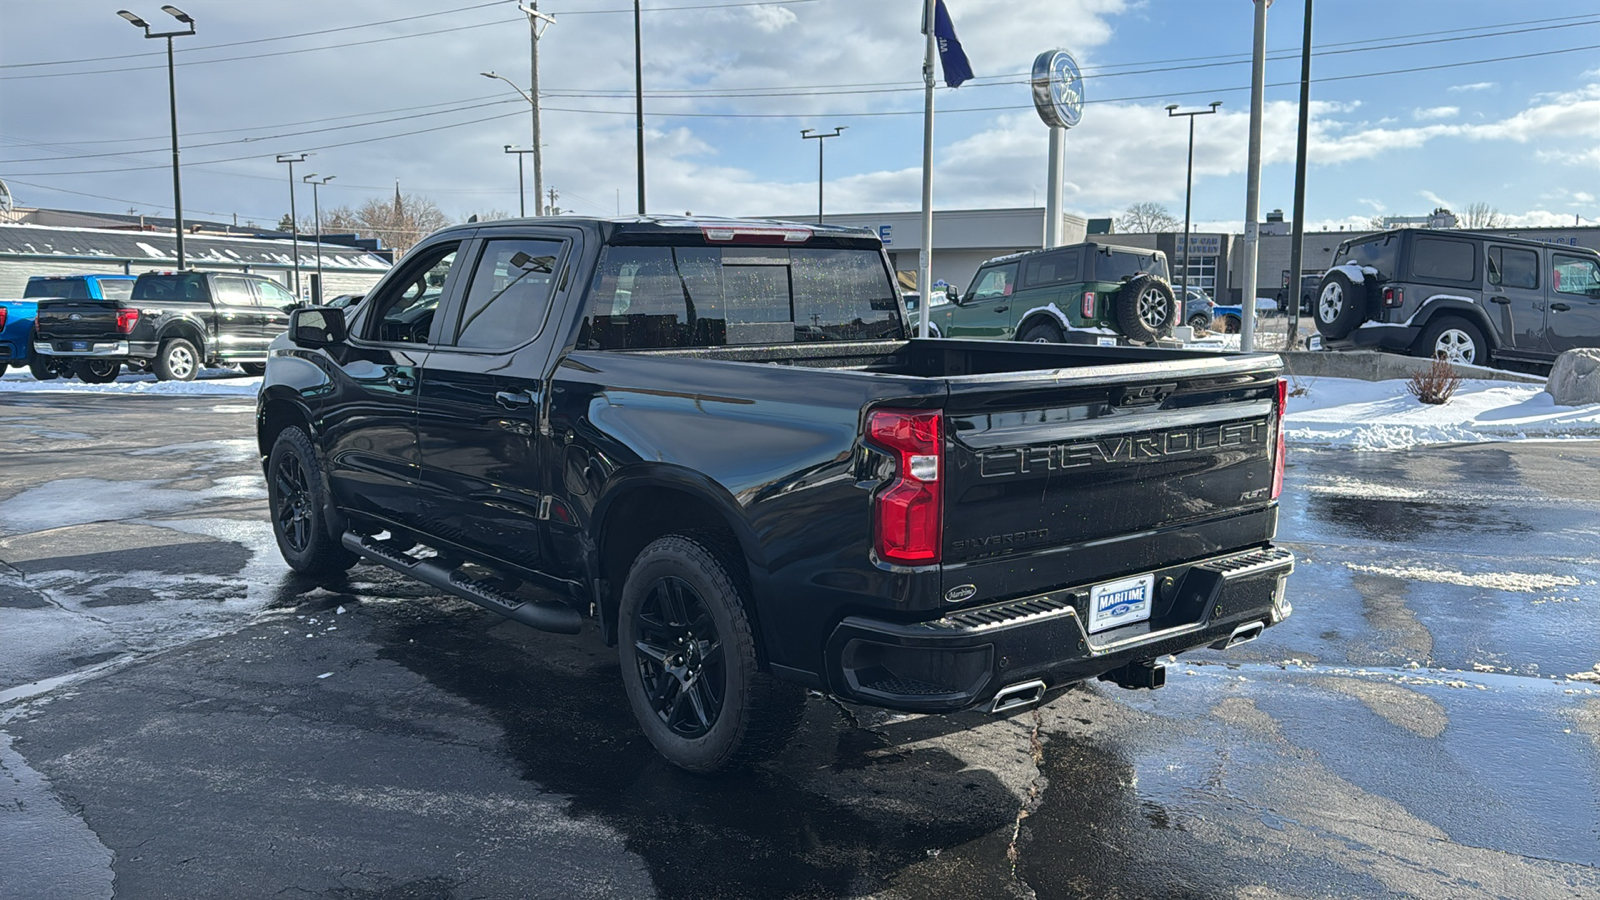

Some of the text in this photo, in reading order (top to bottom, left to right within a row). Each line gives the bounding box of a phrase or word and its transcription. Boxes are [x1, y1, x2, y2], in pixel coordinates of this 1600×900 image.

[978, 420, 1266, 478] CHEVROLET
[952, 528, 1048, 549] SILVERADO
[1099, 587, 1145, 611] MARITIME
